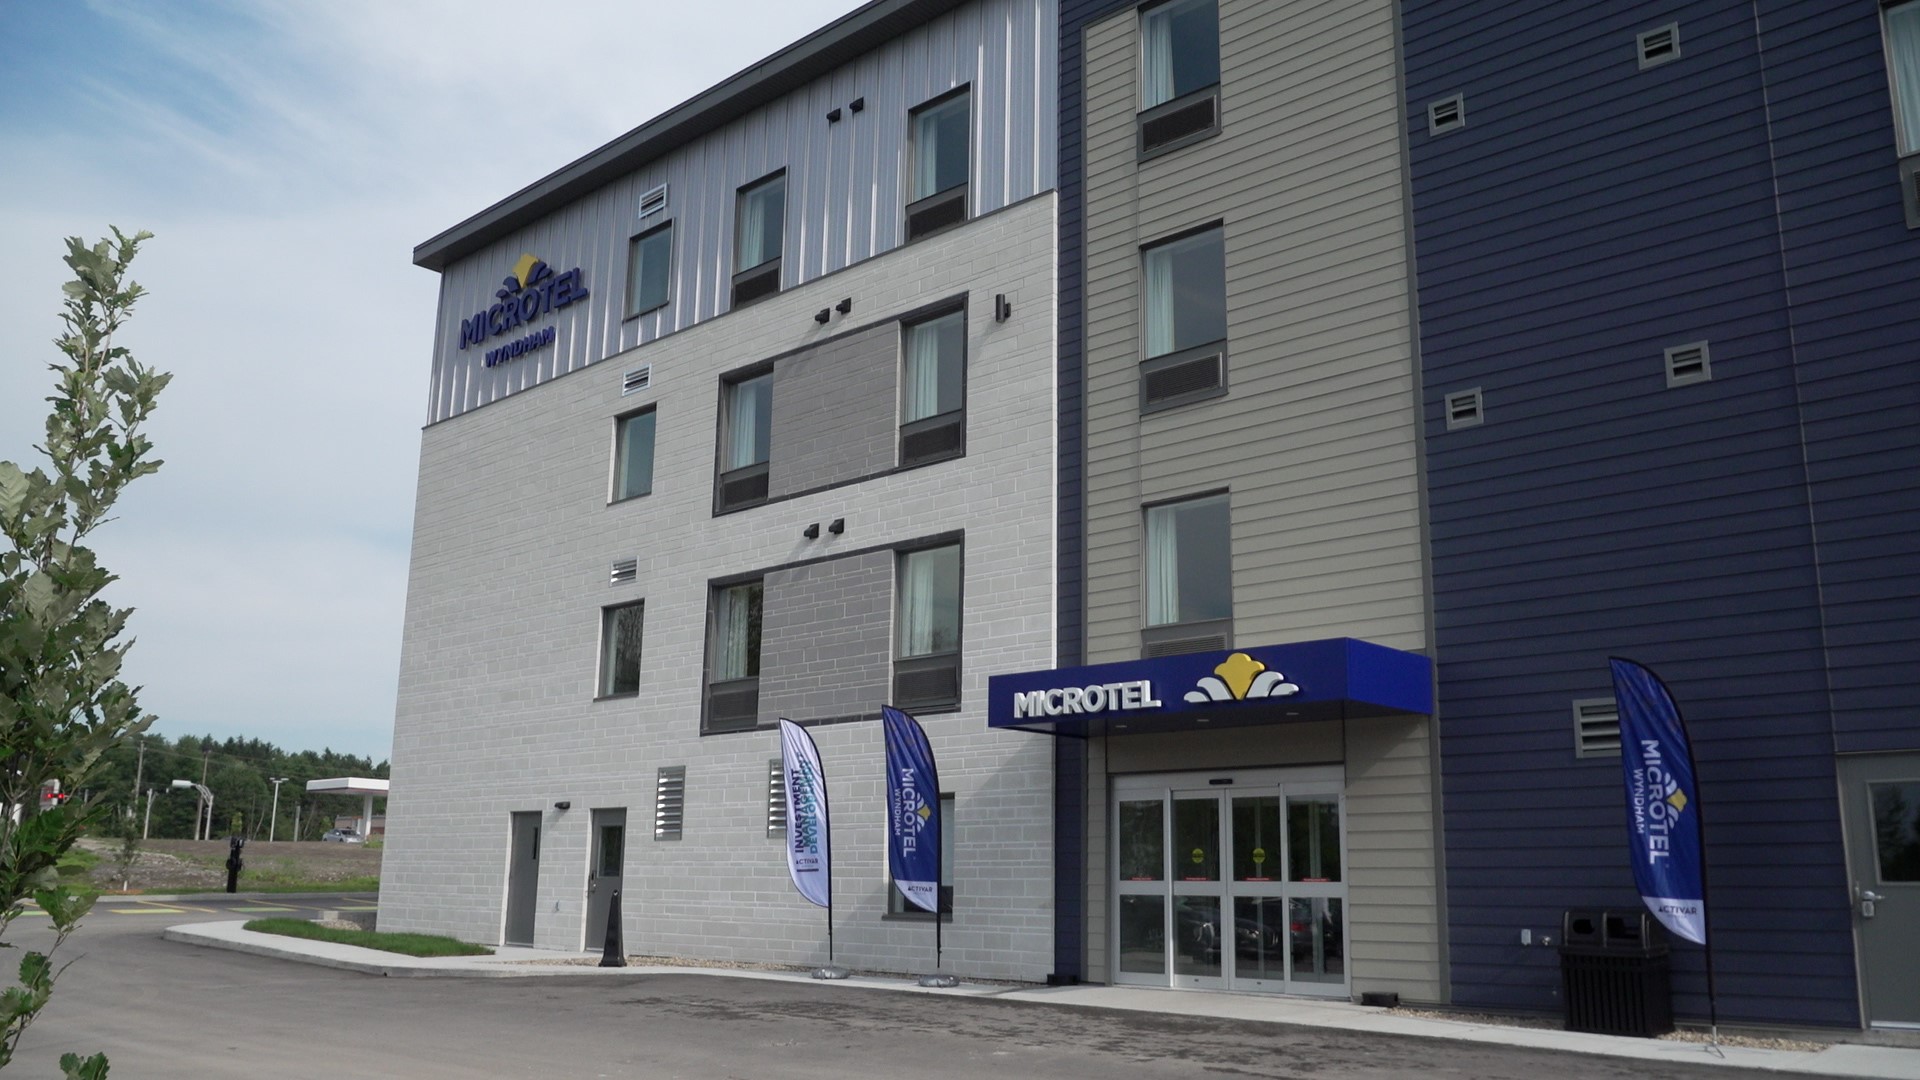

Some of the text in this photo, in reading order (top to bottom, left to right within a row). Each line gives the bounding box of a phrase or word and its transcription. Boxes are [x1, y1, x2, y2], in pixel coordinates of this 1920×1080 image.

[460, 267, 588, 350] MICROTEL
[485, 326, 556, 368] WYNDHAM
[1014, 680, 1161, 718] MICROTEL
[791, 768, 804, 853] INVESTMENT
[902, 768, 916, 858] MICROTEL
[1633, 768, 1644, 834] WYNDHAM
[1641, 739, 1670, 865] MICROTEL
